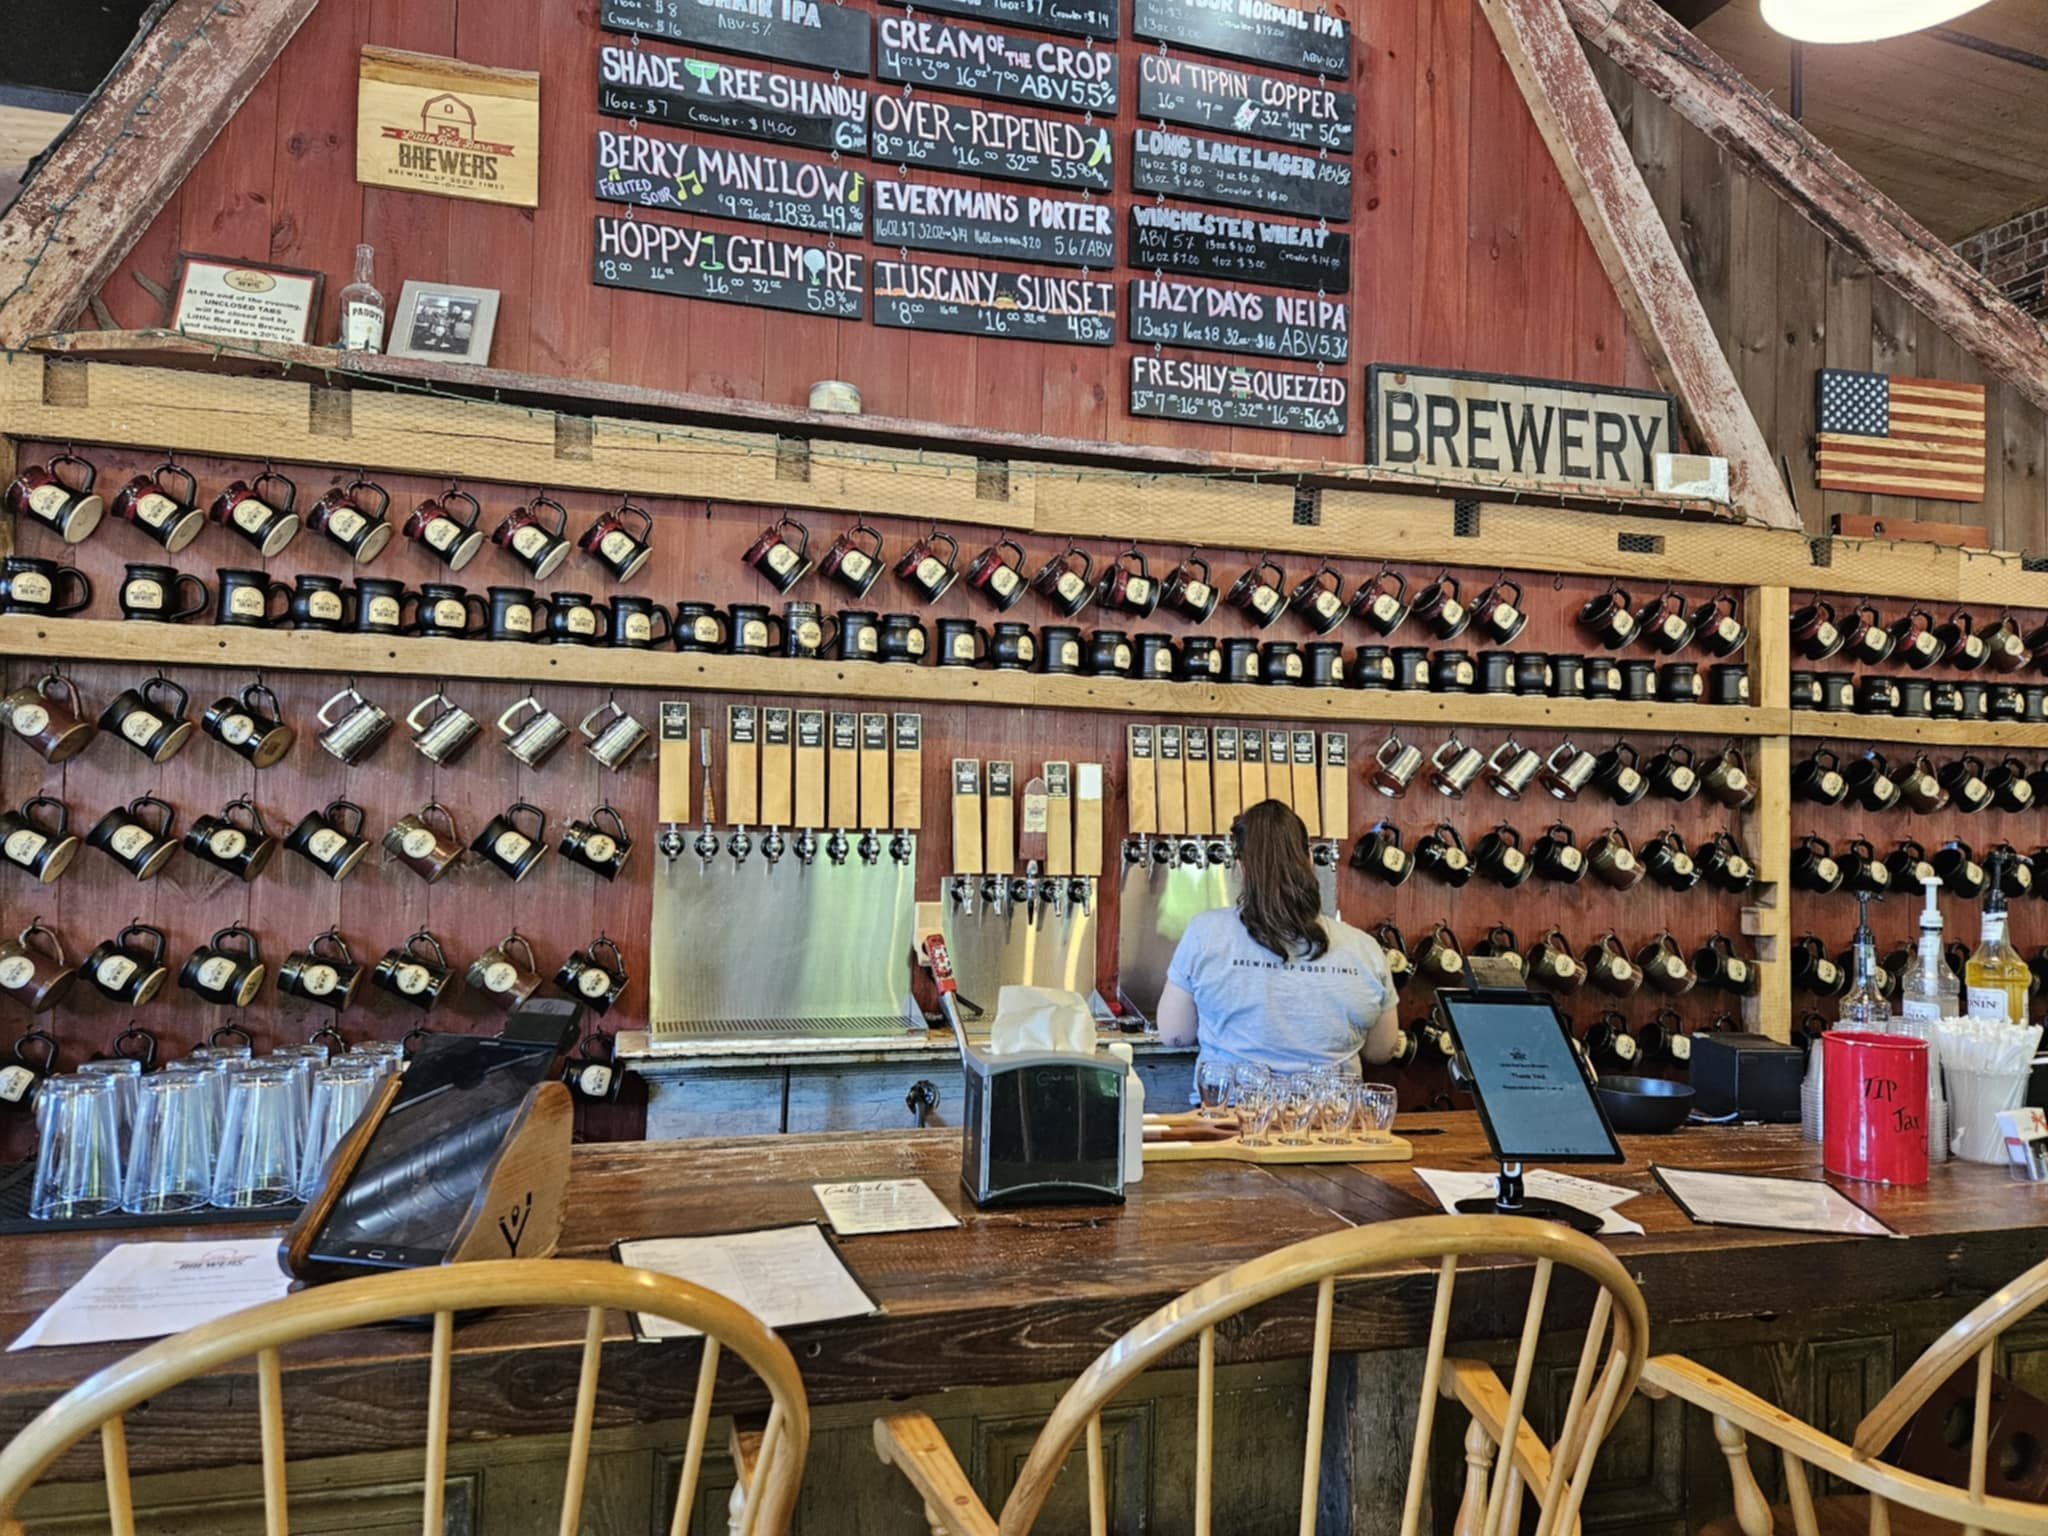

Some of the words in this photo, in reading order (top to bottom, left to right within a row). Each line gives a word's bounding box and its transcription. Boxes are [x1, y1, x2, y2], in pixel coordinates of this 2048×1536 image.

[782, 0, 822, 28] IPA
[1238, 0, 1308, 30] NORMAL
[1314, 14, 1345, 39] IPA
[881, 18, 985, 65] CREAM
[986, 34, 1005, 57] OF
[1005, 50, 1033, 69] THE
[1036, 42, 1113, 82] CROP
[602, 46, 684, 91] SHADE
[769, 74, 868, 123] SHANDY
[1020, 74, 1069, 101] ABV
[1142, 56, 1182, 86] COW
[1262, 79, 1339, 121] COPPER
[400, 143, 498, 181] BREWERS
[600, 131, 689, 179] BERRY
[699, 147, 849, 203] MANILOW
[1135, 129, 1194, 160] LONG
[1197, 139, 1252, 168] LAKE
[1252, 148, 1317, 180] LAGER
[600, 178, 653, 198] FRUITED
[640, 186, 682, 206] SOUR
[875, 180, 1020, 222] EVERYMAN'S
[1028, 197, 1113, 236] PORTER
[600, 218, 702, 267] HOPPY
[1133, 205, 1255, 242] WINCHESTER
[1260, 222, 1330, 250] WHEAT
[1139, 230, 1169, 249] ABV
[200, 289, 214, 297] the
[217, 292, 234, 300] end
[248, 296, 262, 304] the
[876, 260, 998, 309] TUSCANY
[1016, 273, 1114, 315] SUNSET
[1138, 279, 1204, 315] HAZY
[1205, 287, 1263, 321] DAYS
[1276, 297, 1347, 332] NEIPA
[187, 312, 211, 321] Little
[214, 316, 231, 324] Red
[234, 319, 255, 328] Barn
[258, 322, 295, 334] Brewers
[195, 306, 212, 314] will
[214, 307, 225, 316] be
[227, 311, 257, 320] closed
[260, 315, 275, 323] out
[277, 316, 288, 325] by
[205, 299, 255, 311] UNCLOSED
[258, 306, 281, 316] TABS
[203, 323, 237, 334] subject
[1279, 328, 1317, 356] ABV
[1134, 356, 1228, 394] FRESHLY
[1385, 390, 1662, 484] BREWERY
[1233, 959, 1278, 970] BREWING
[1330, 966, 1359, 976] TIMES
[1891, 1106, 1922, 1133] Jar
